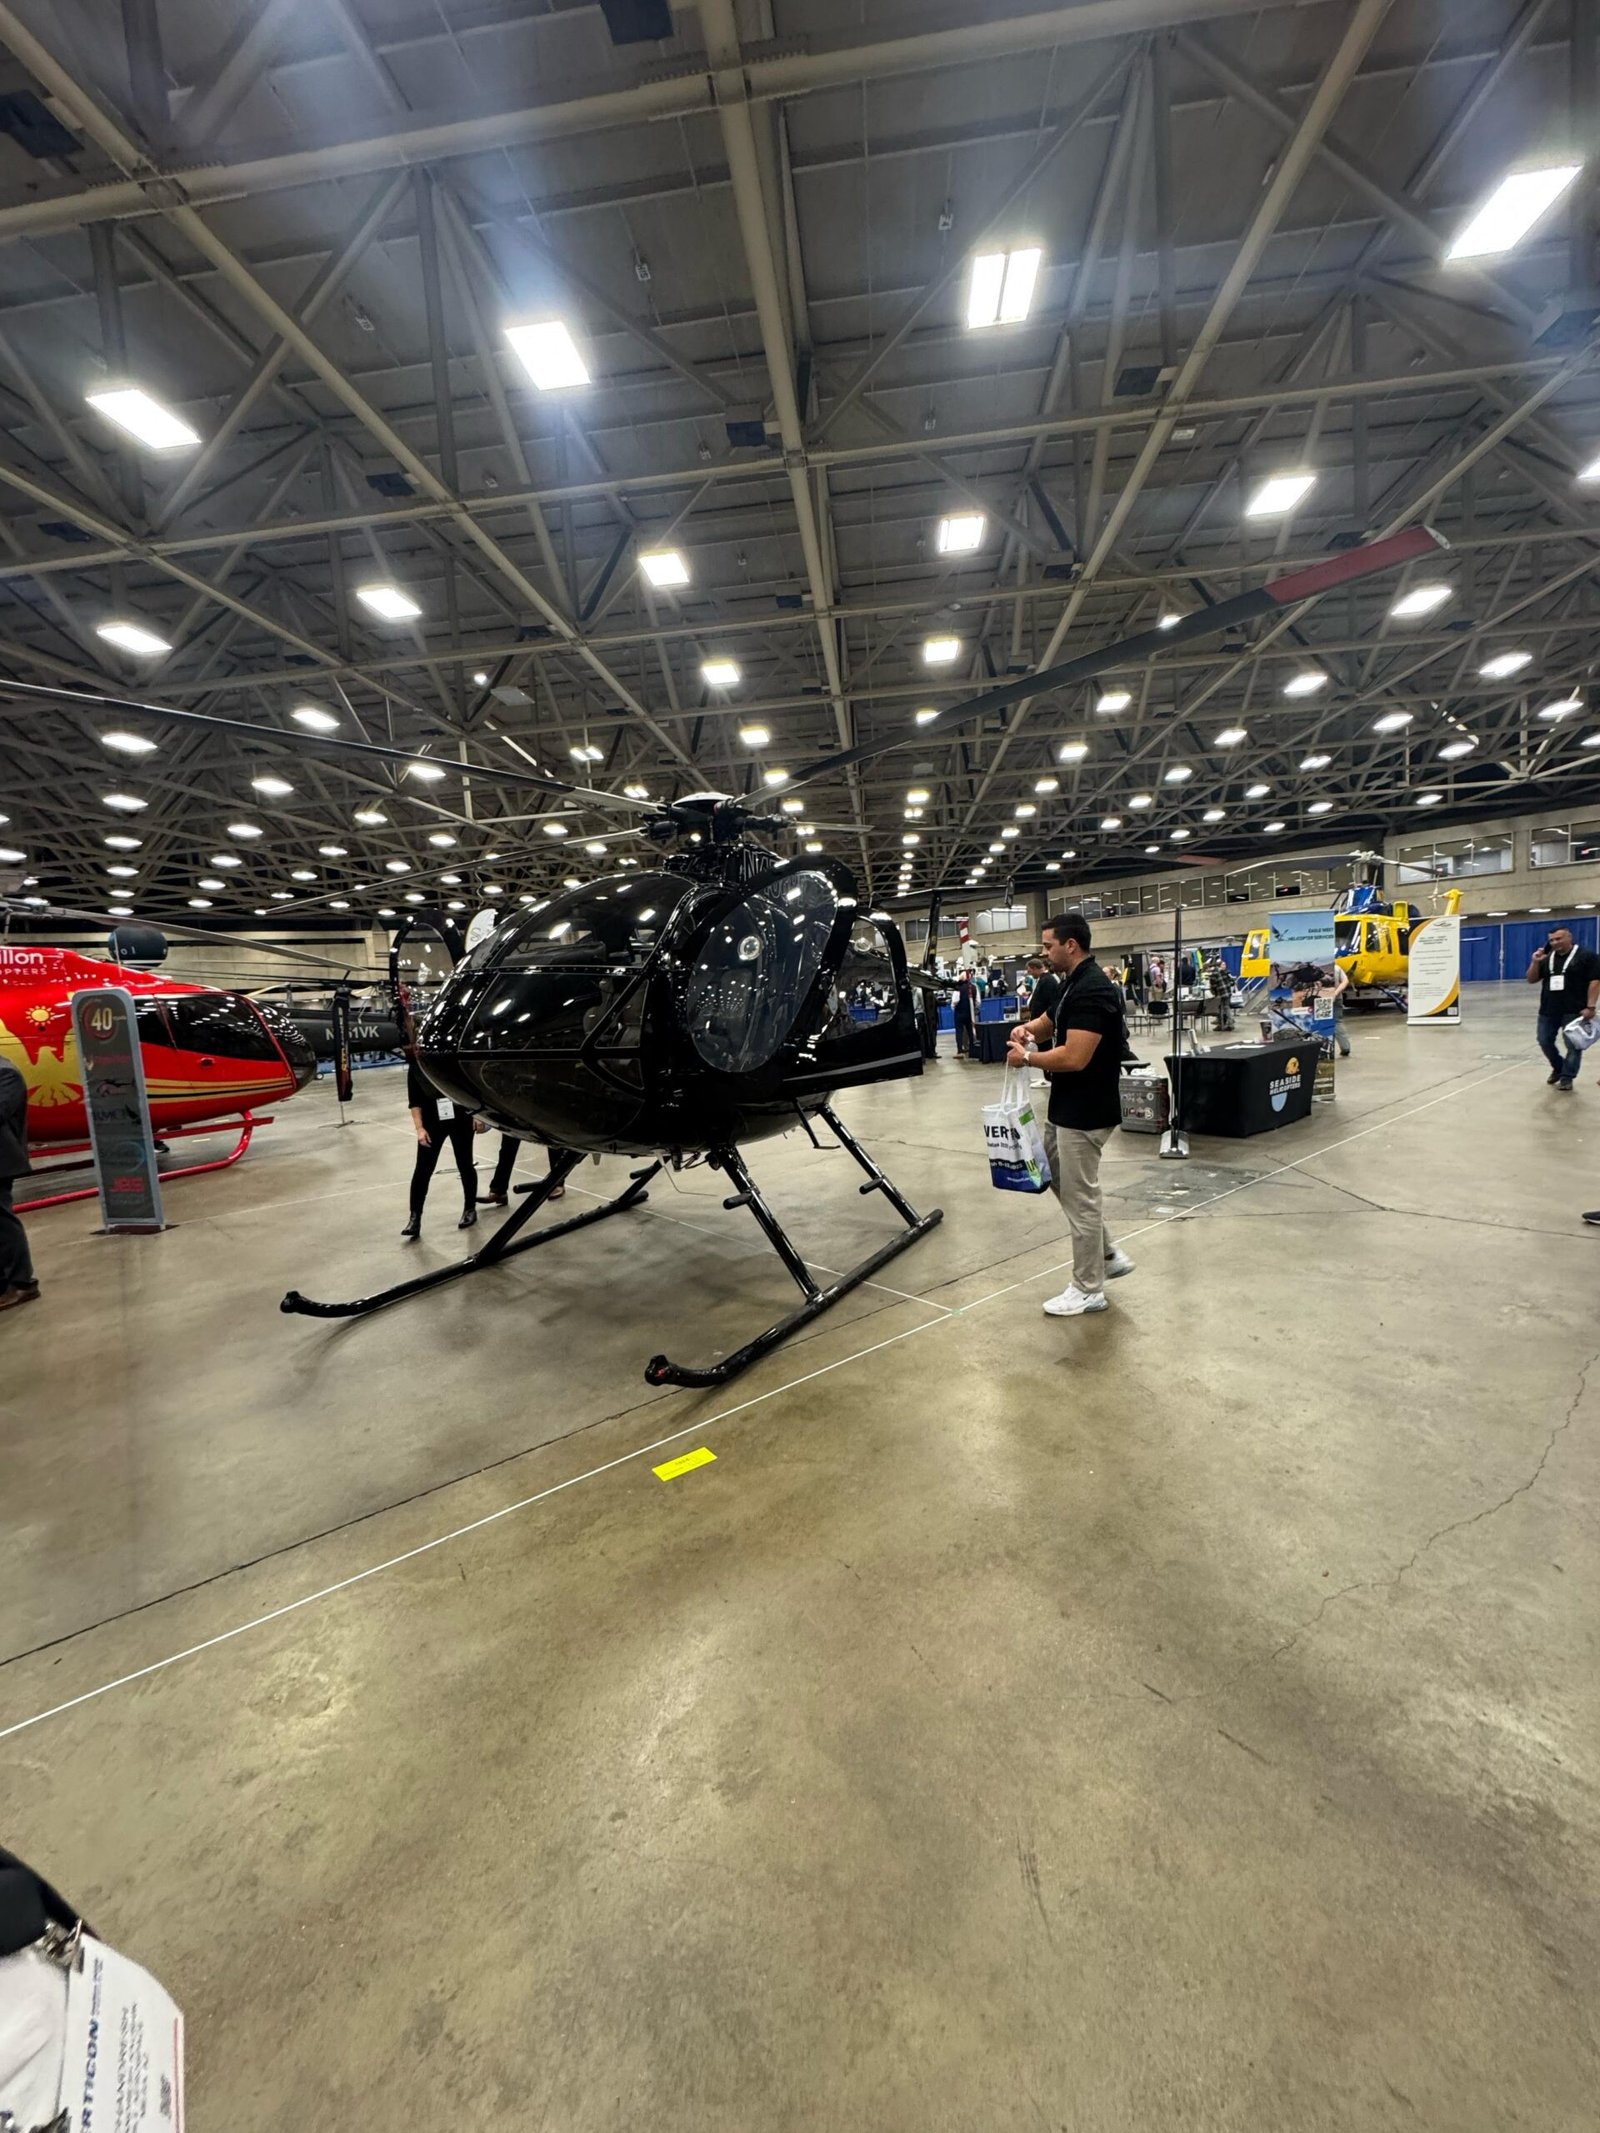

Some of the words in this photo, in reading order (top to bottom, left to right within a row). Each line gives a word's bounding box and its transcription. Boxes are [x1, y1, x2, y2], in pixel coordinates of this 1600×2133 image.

[91, 1007, 112, 1031] 40
[1270, 1075, 1301, 1089] SEASIDE
[1270, 1082, 1301, 1095] HELICOPTERS
[80, 2019, 99, 2133] RTICON
